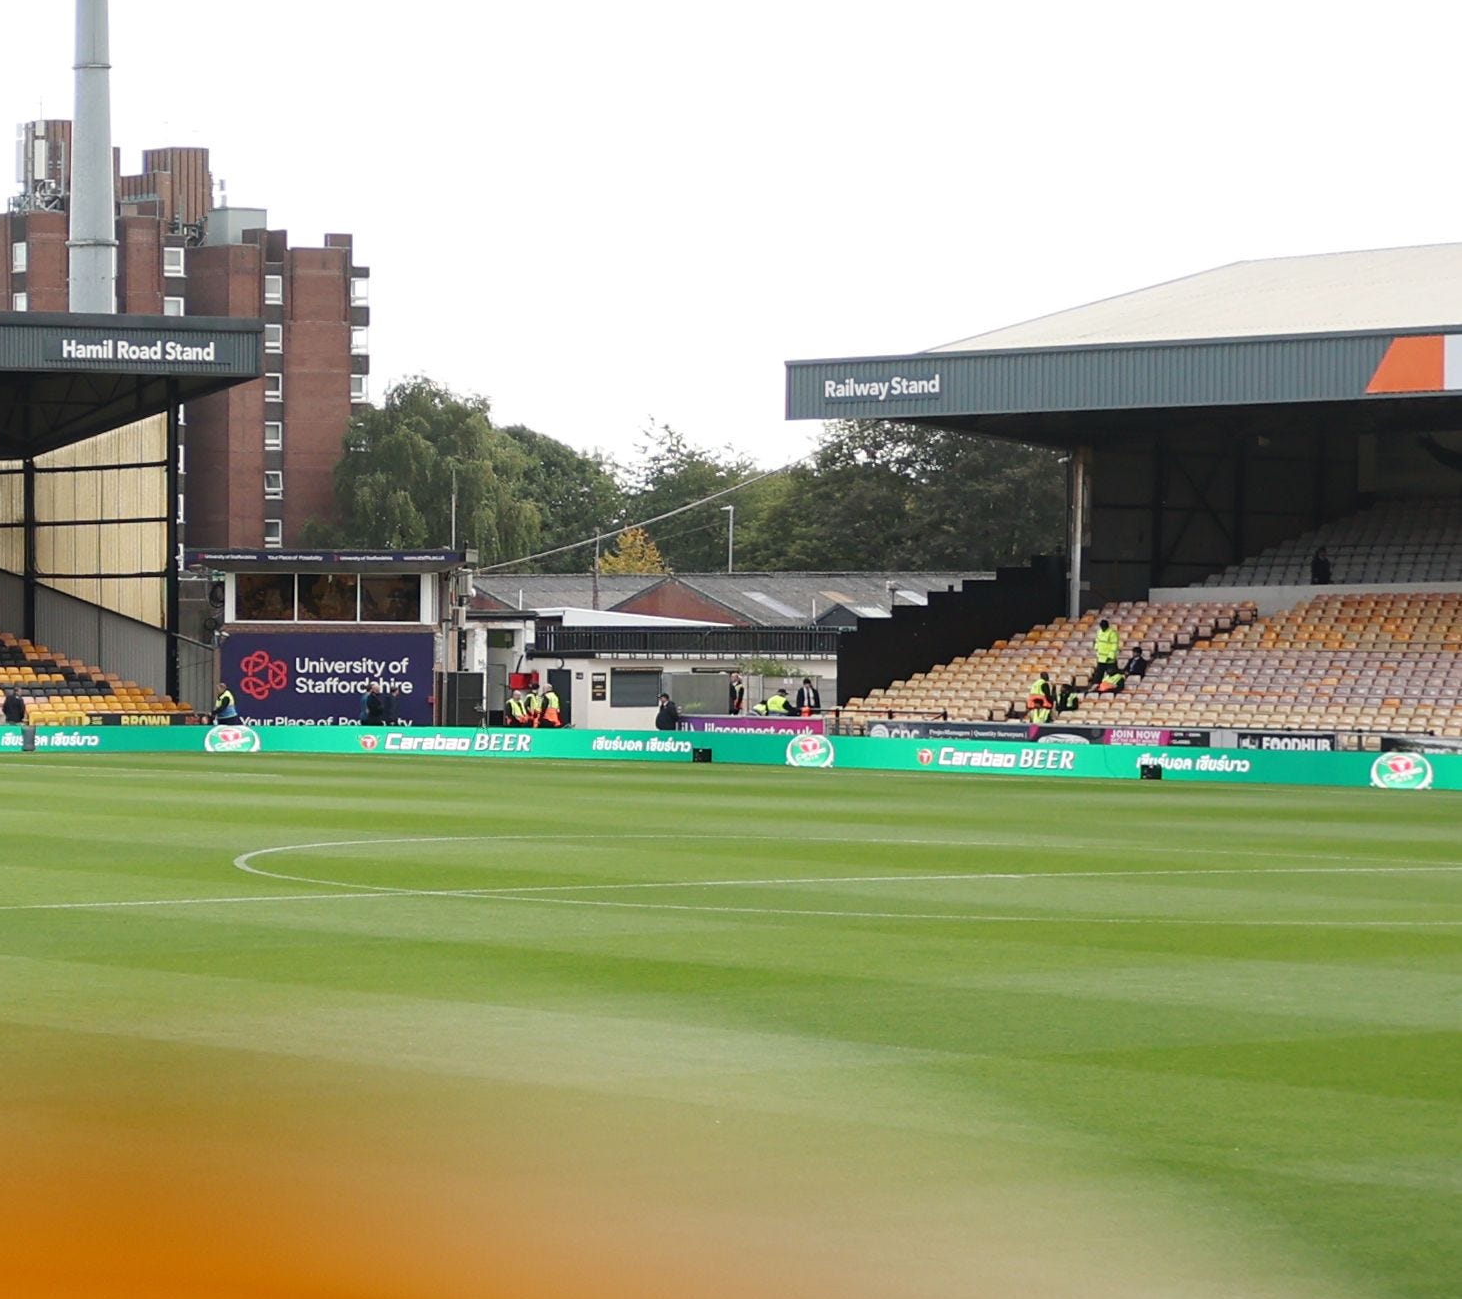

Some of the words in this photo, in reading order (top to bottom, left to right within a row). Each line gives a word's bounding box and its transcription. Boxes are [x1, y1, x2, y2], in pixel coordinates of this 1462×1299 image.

[62, 339, 112, 359] Hamil
[117, 340, 161, 360] Road
[165, 341, 215, 361] Stand
[824, 377, 889, 401] Railway
[890, 374, 940, 396] Stand
[295, 657, 384, 677] University
[388, 657, 409, 673] of
[704, 722, 814, 735] lilaconnectcouk
[1110, 729, 1134, 739] JOIN
[1136, 729, 1162, 740] NOW
[384, 733, 471, 751] Carabao
[474, 733, 532, 752] BEER
[938, 746, 1016, 768] Carabao
[1019, 748, 1075, 769] BEER
